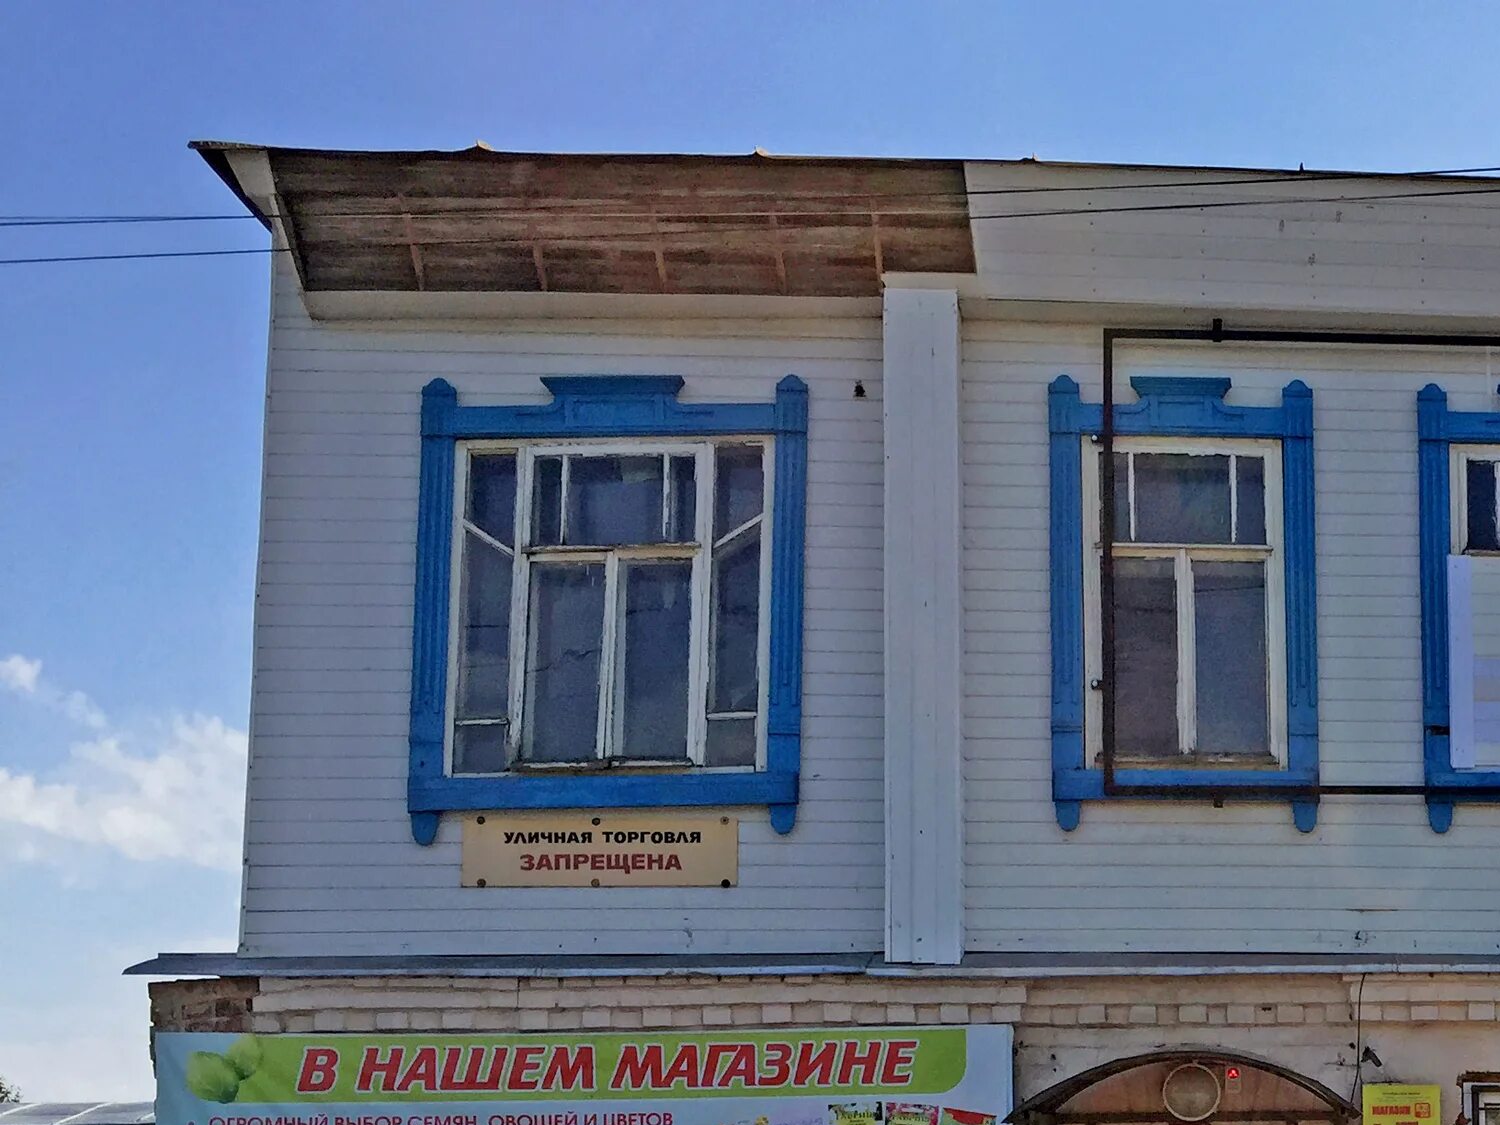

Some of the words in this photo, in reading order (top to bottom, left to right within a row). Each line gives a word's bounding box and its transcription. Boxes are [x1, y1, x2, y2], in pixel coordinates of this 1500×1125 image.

[504, 832, 592, 844] УЛИЧНАЯ
[602, 831, 701, 844] ТОРГОВЛЯ
[520, 854, 682, 874] ЗАПРЕЩЕНА
[296, 1047, 341, 1093] В
[357, 1045, 596, 1092] НАШЕМ
[610, 1040, 918, 1089] МАГАЗИНЕ
